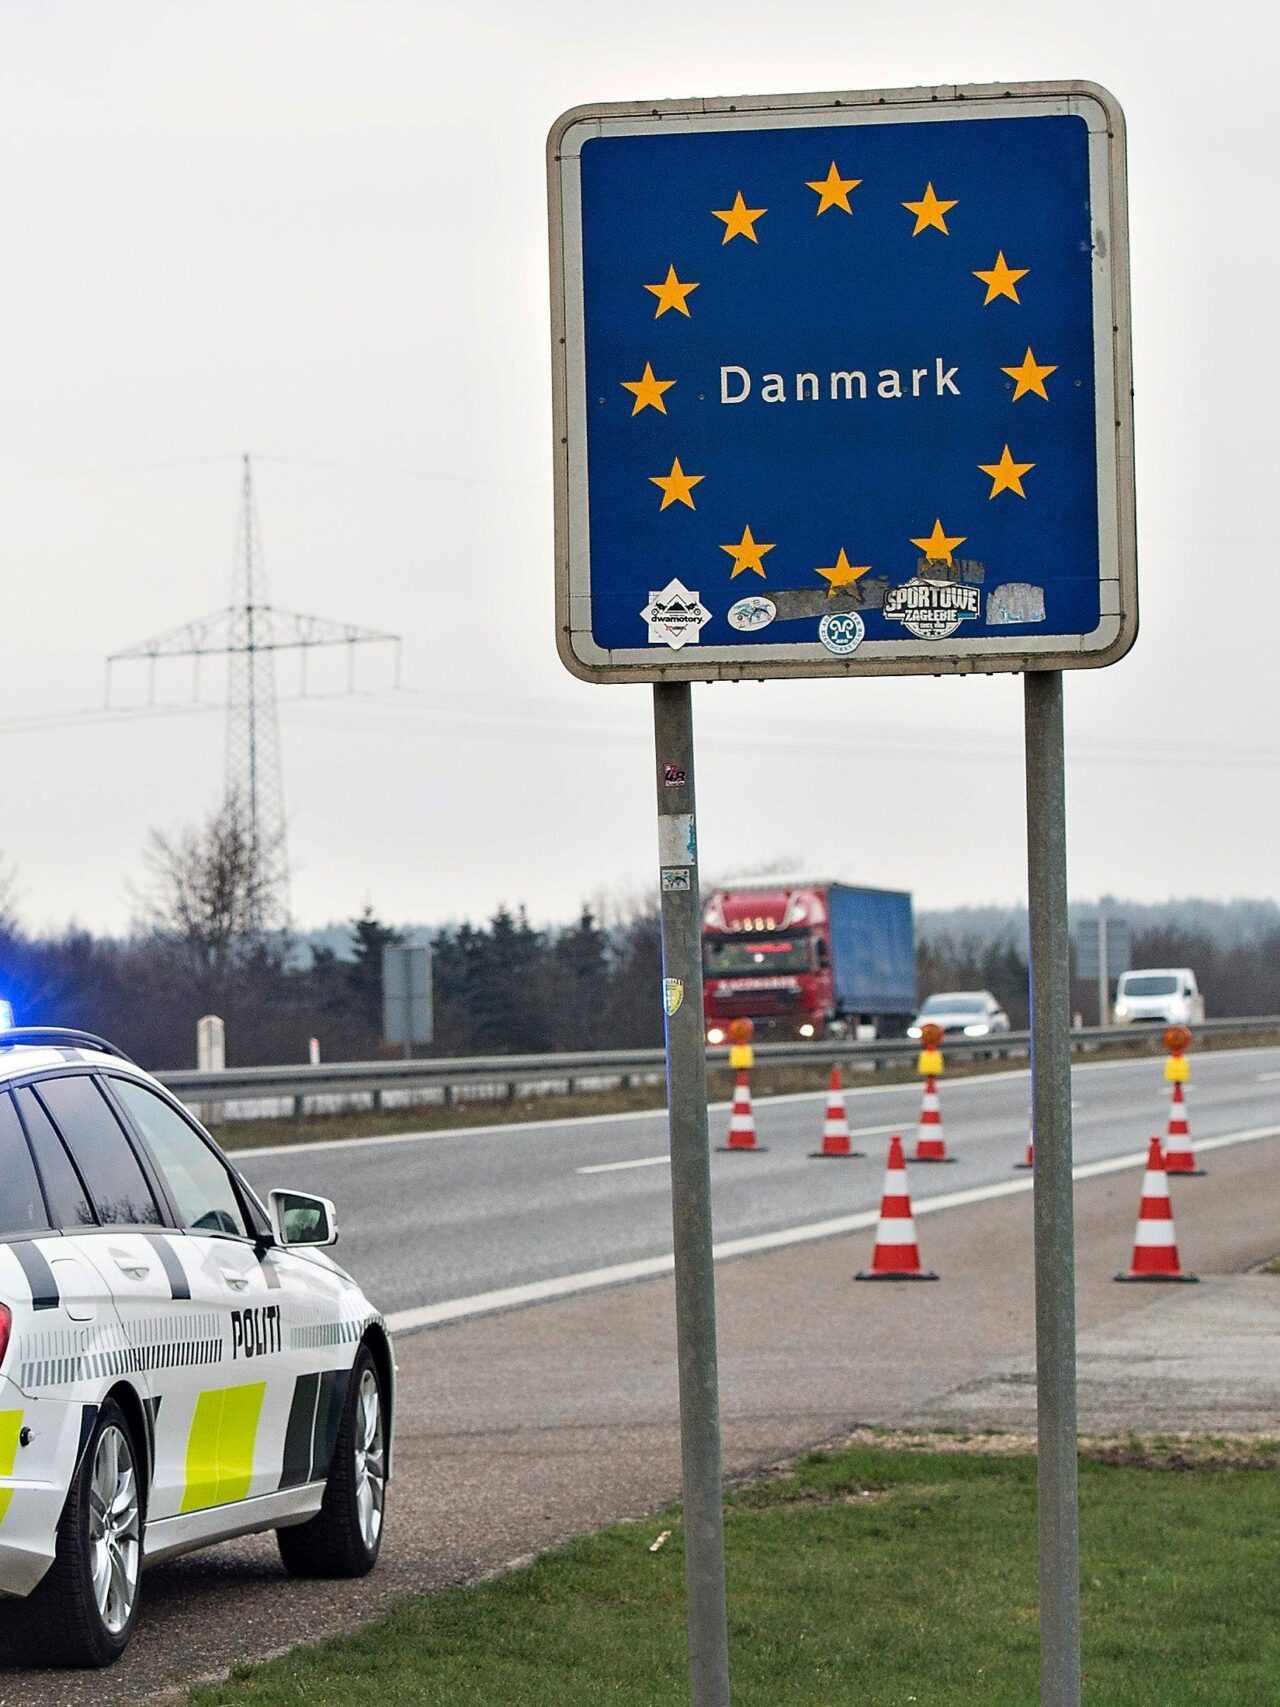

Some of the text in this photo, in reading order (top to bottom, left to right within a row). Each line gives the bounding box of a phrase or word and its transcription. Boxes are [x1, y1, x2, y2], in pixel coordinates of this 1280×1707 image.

[720, 357, 961, 404] Danmark
[885, 586, 978, 612] SPORTOWE
[231, 1305, 281, 1359] POLITI
